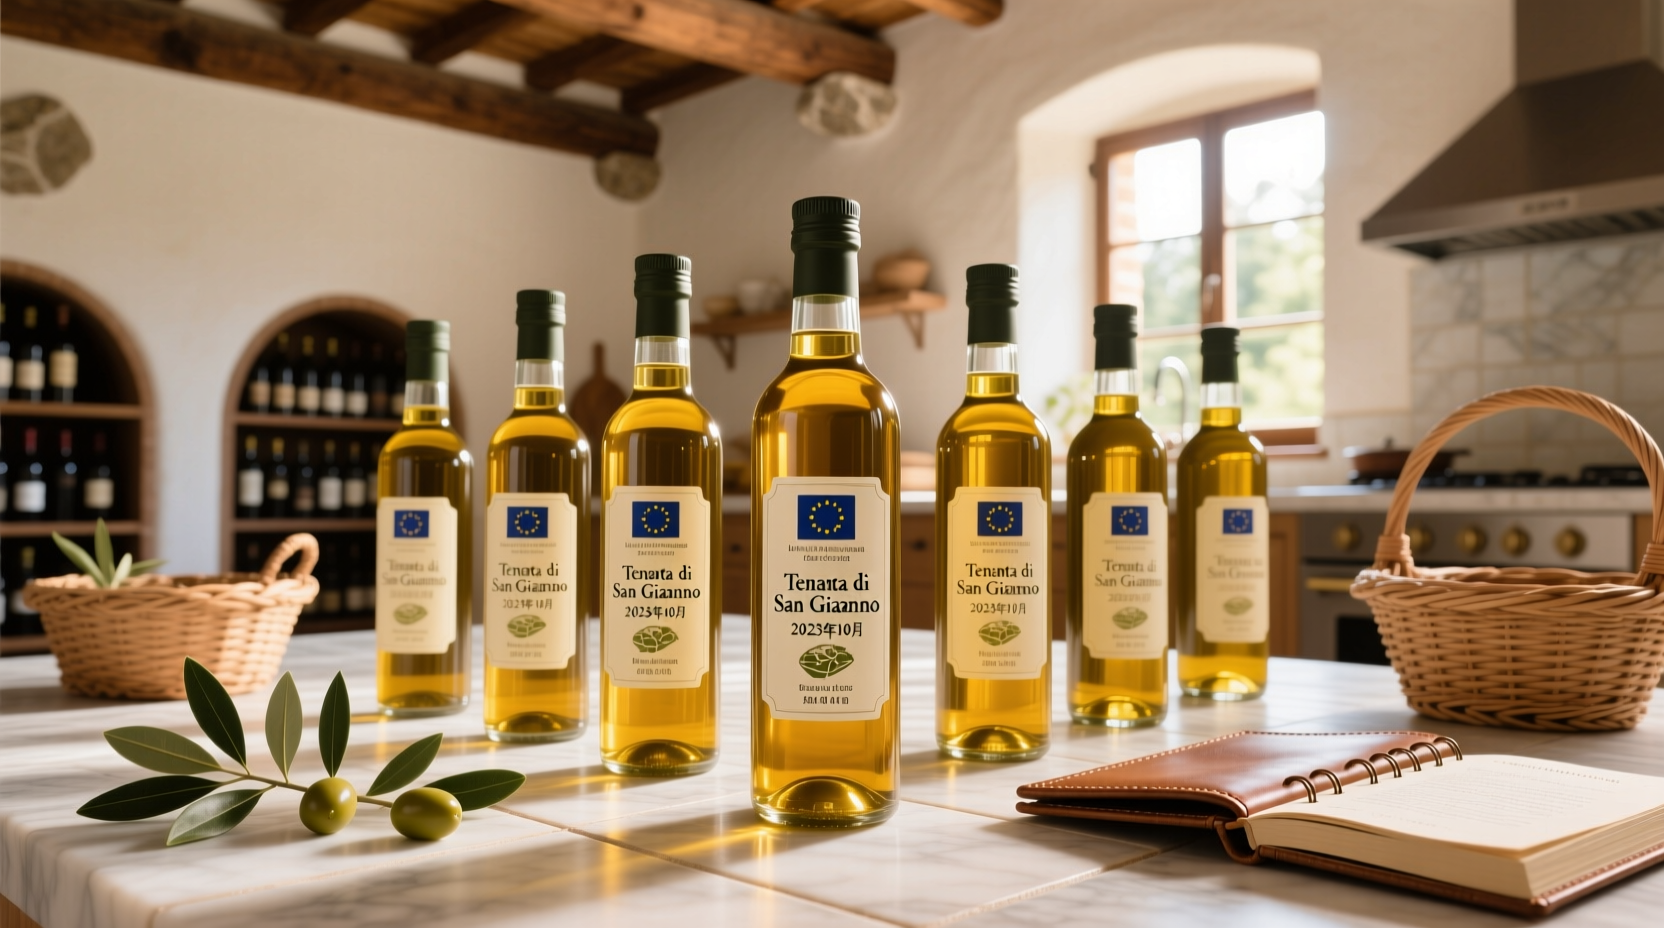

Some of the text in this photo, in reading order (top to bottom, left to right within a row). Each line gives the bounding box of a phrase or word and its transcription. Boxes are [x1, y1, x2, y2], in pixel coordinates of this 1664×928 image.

[547, 562, 559, 576] di
[678, 565, 692, 580] di
[1021, 562, 1033, 578] di
[492, 578, 512, 592] San
[853, 572, 869, 591] di
[957, 580, 981, 595] San
[1095, 573, 1117, 587] San
[613, 583, 636, 598] San
[774, 594, 804, 613] San
[791, 622, 863, 640] 2023年10月
